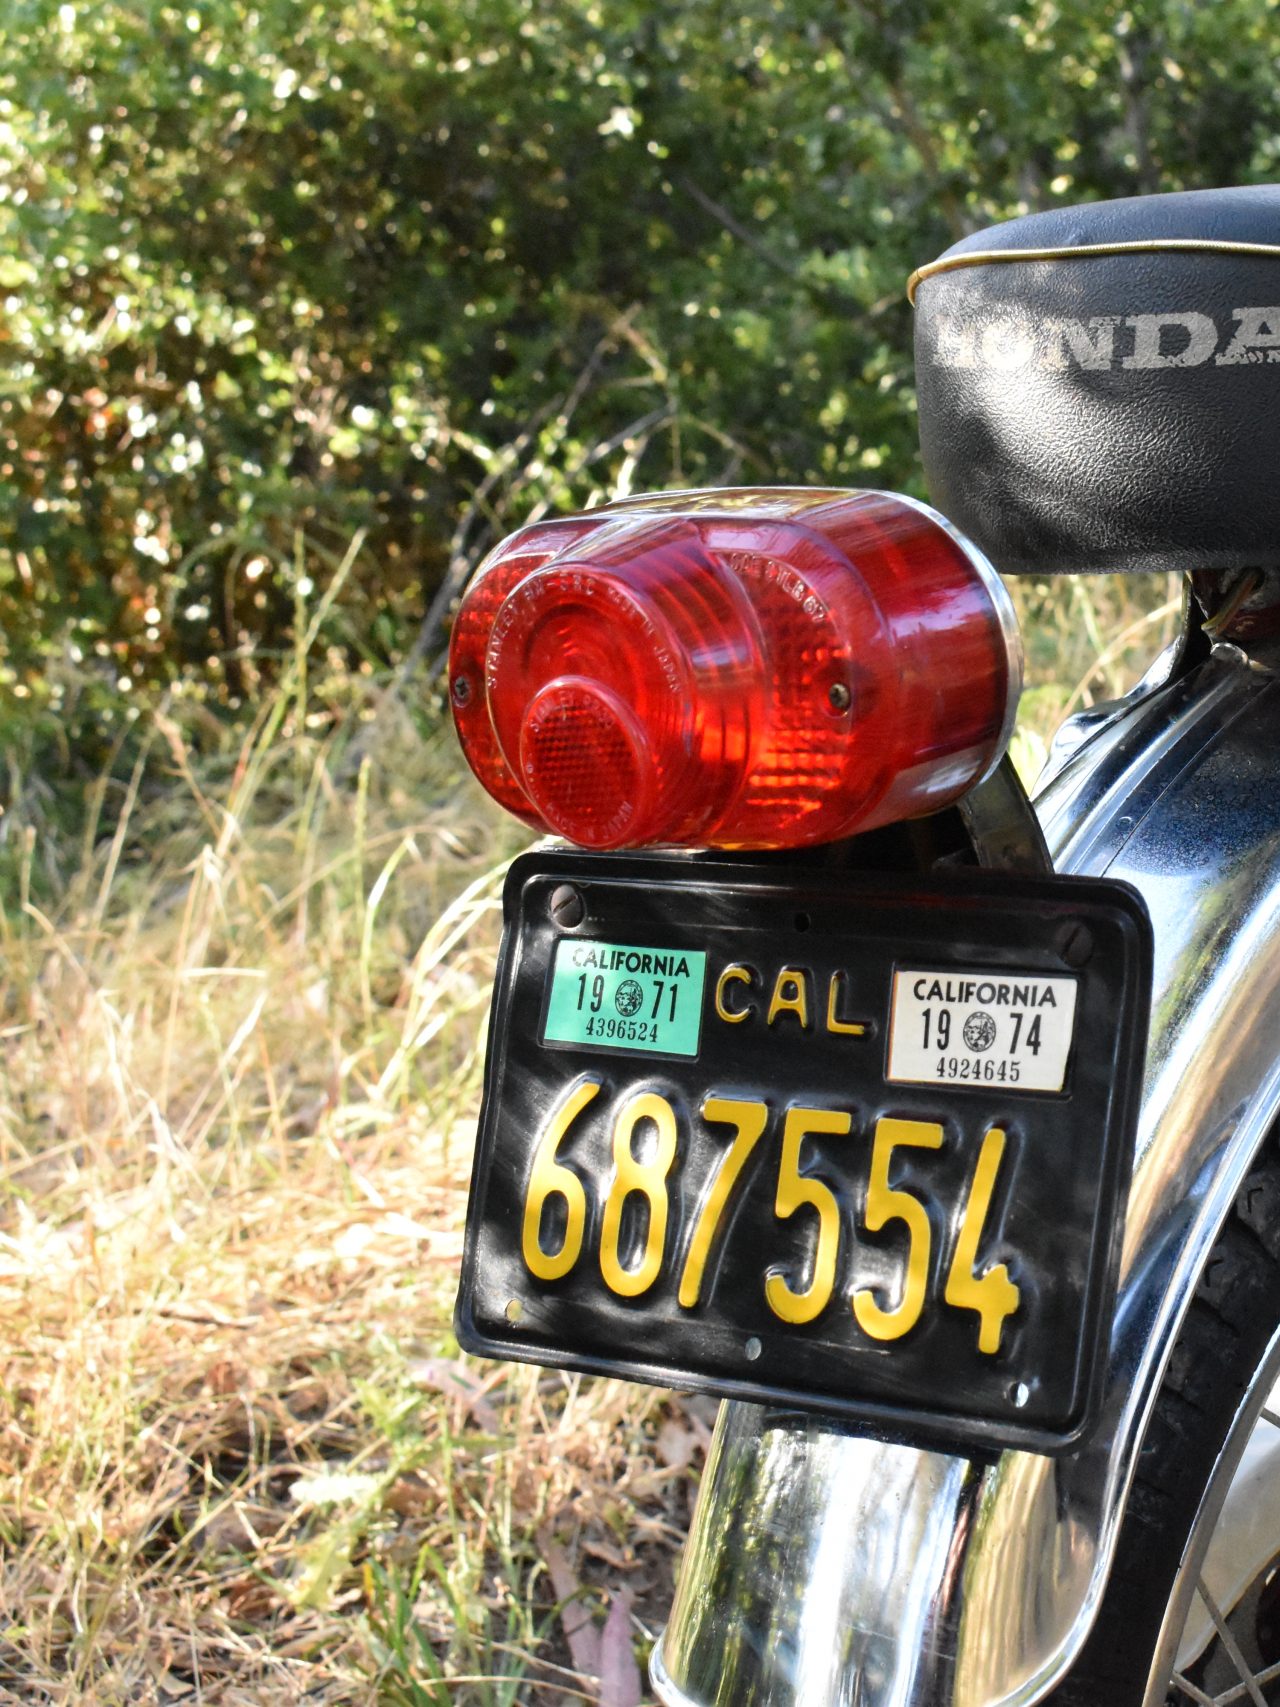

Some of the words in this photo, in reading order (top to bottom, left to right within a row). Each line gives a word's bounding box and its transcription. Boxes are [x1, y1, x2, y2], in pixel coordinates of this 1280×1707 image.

[572, 947, 690, 978] CALIFORNIA
[577, 972, 605, 1013] 19
[651, 980, 678, 1022] 71
[715, 966, 865, 1036] CAL
[913, 978, 1057, 1008] CALIFORNIA
[586, 1016, 658, 1043] 4396524
[922, 1007, 951, 1051] 19
[1009, 1012, 1042, 1056] 74
[936, 1056, 1021, 1082] 4924645
[522, 1082, 1019, 1354] 687554
